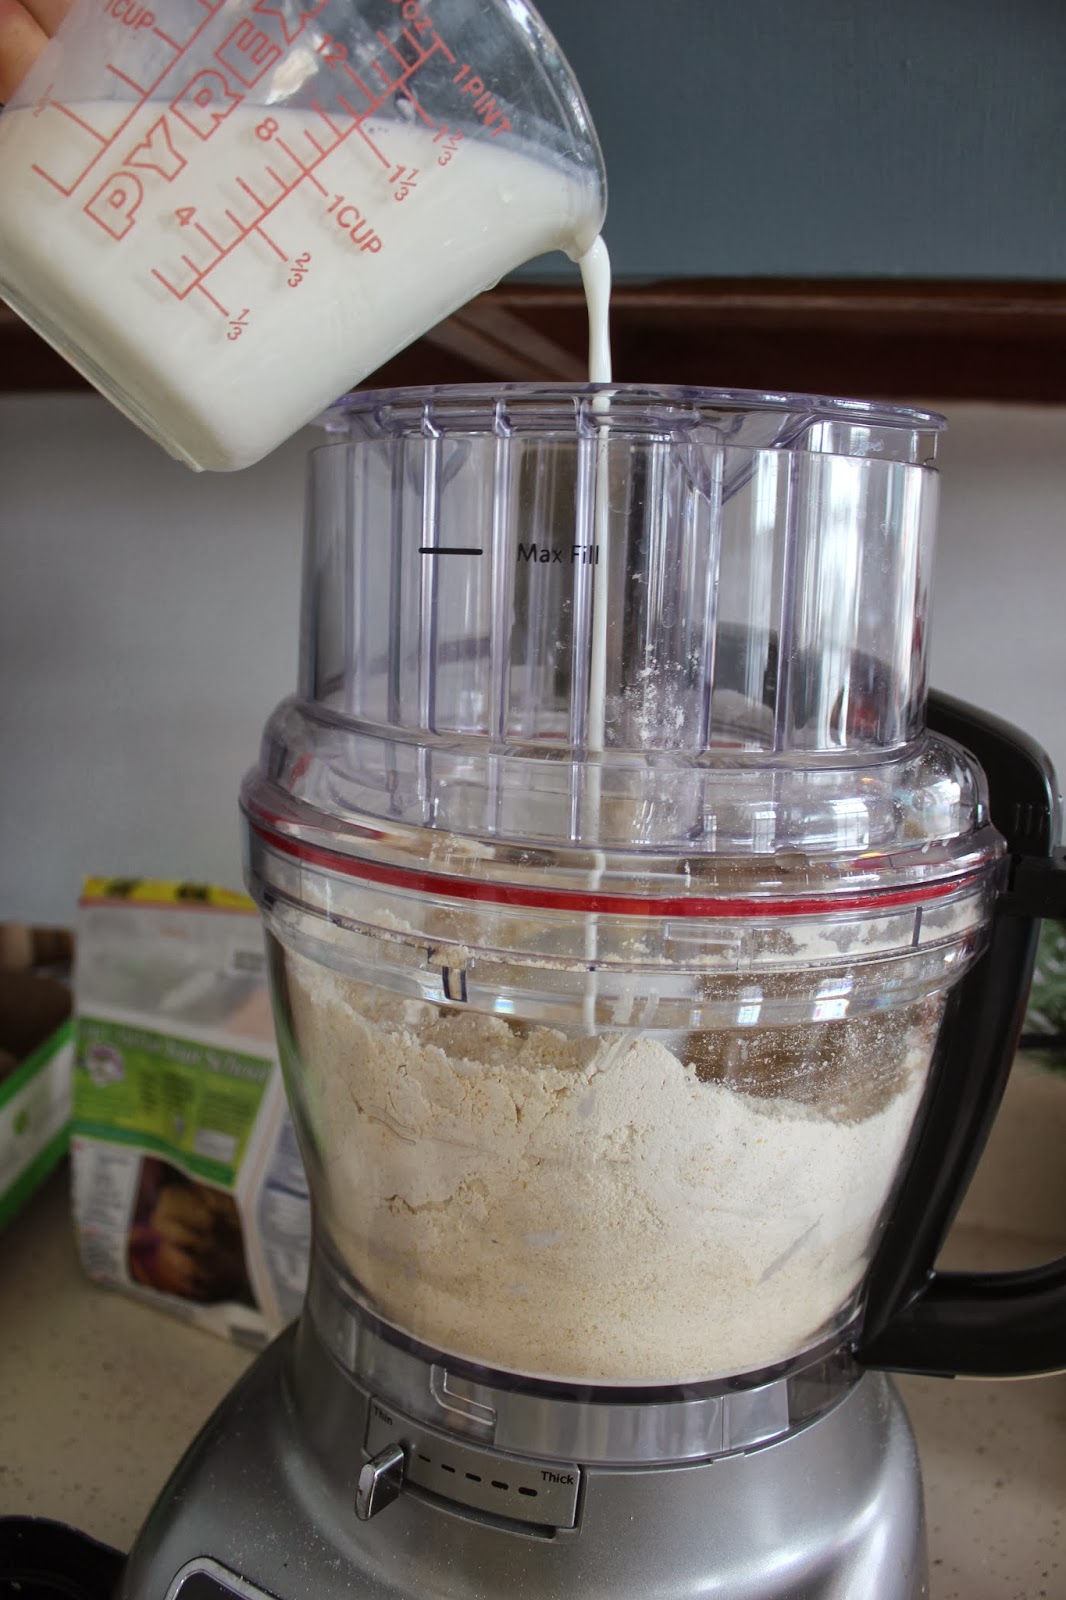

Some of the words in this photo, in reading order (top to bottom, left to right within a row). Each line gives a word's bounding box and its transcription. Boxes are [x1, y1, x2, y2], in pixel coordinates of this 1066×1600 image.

[316, 33, 347, 69] 12
[254, 117, 280, 142] 8
[174, 206, 197, 227] 4
[516, 542, 562, 564] Max
[570, 544, 600, 565] Fill
[541, 1471, 575, 1486] Thick
